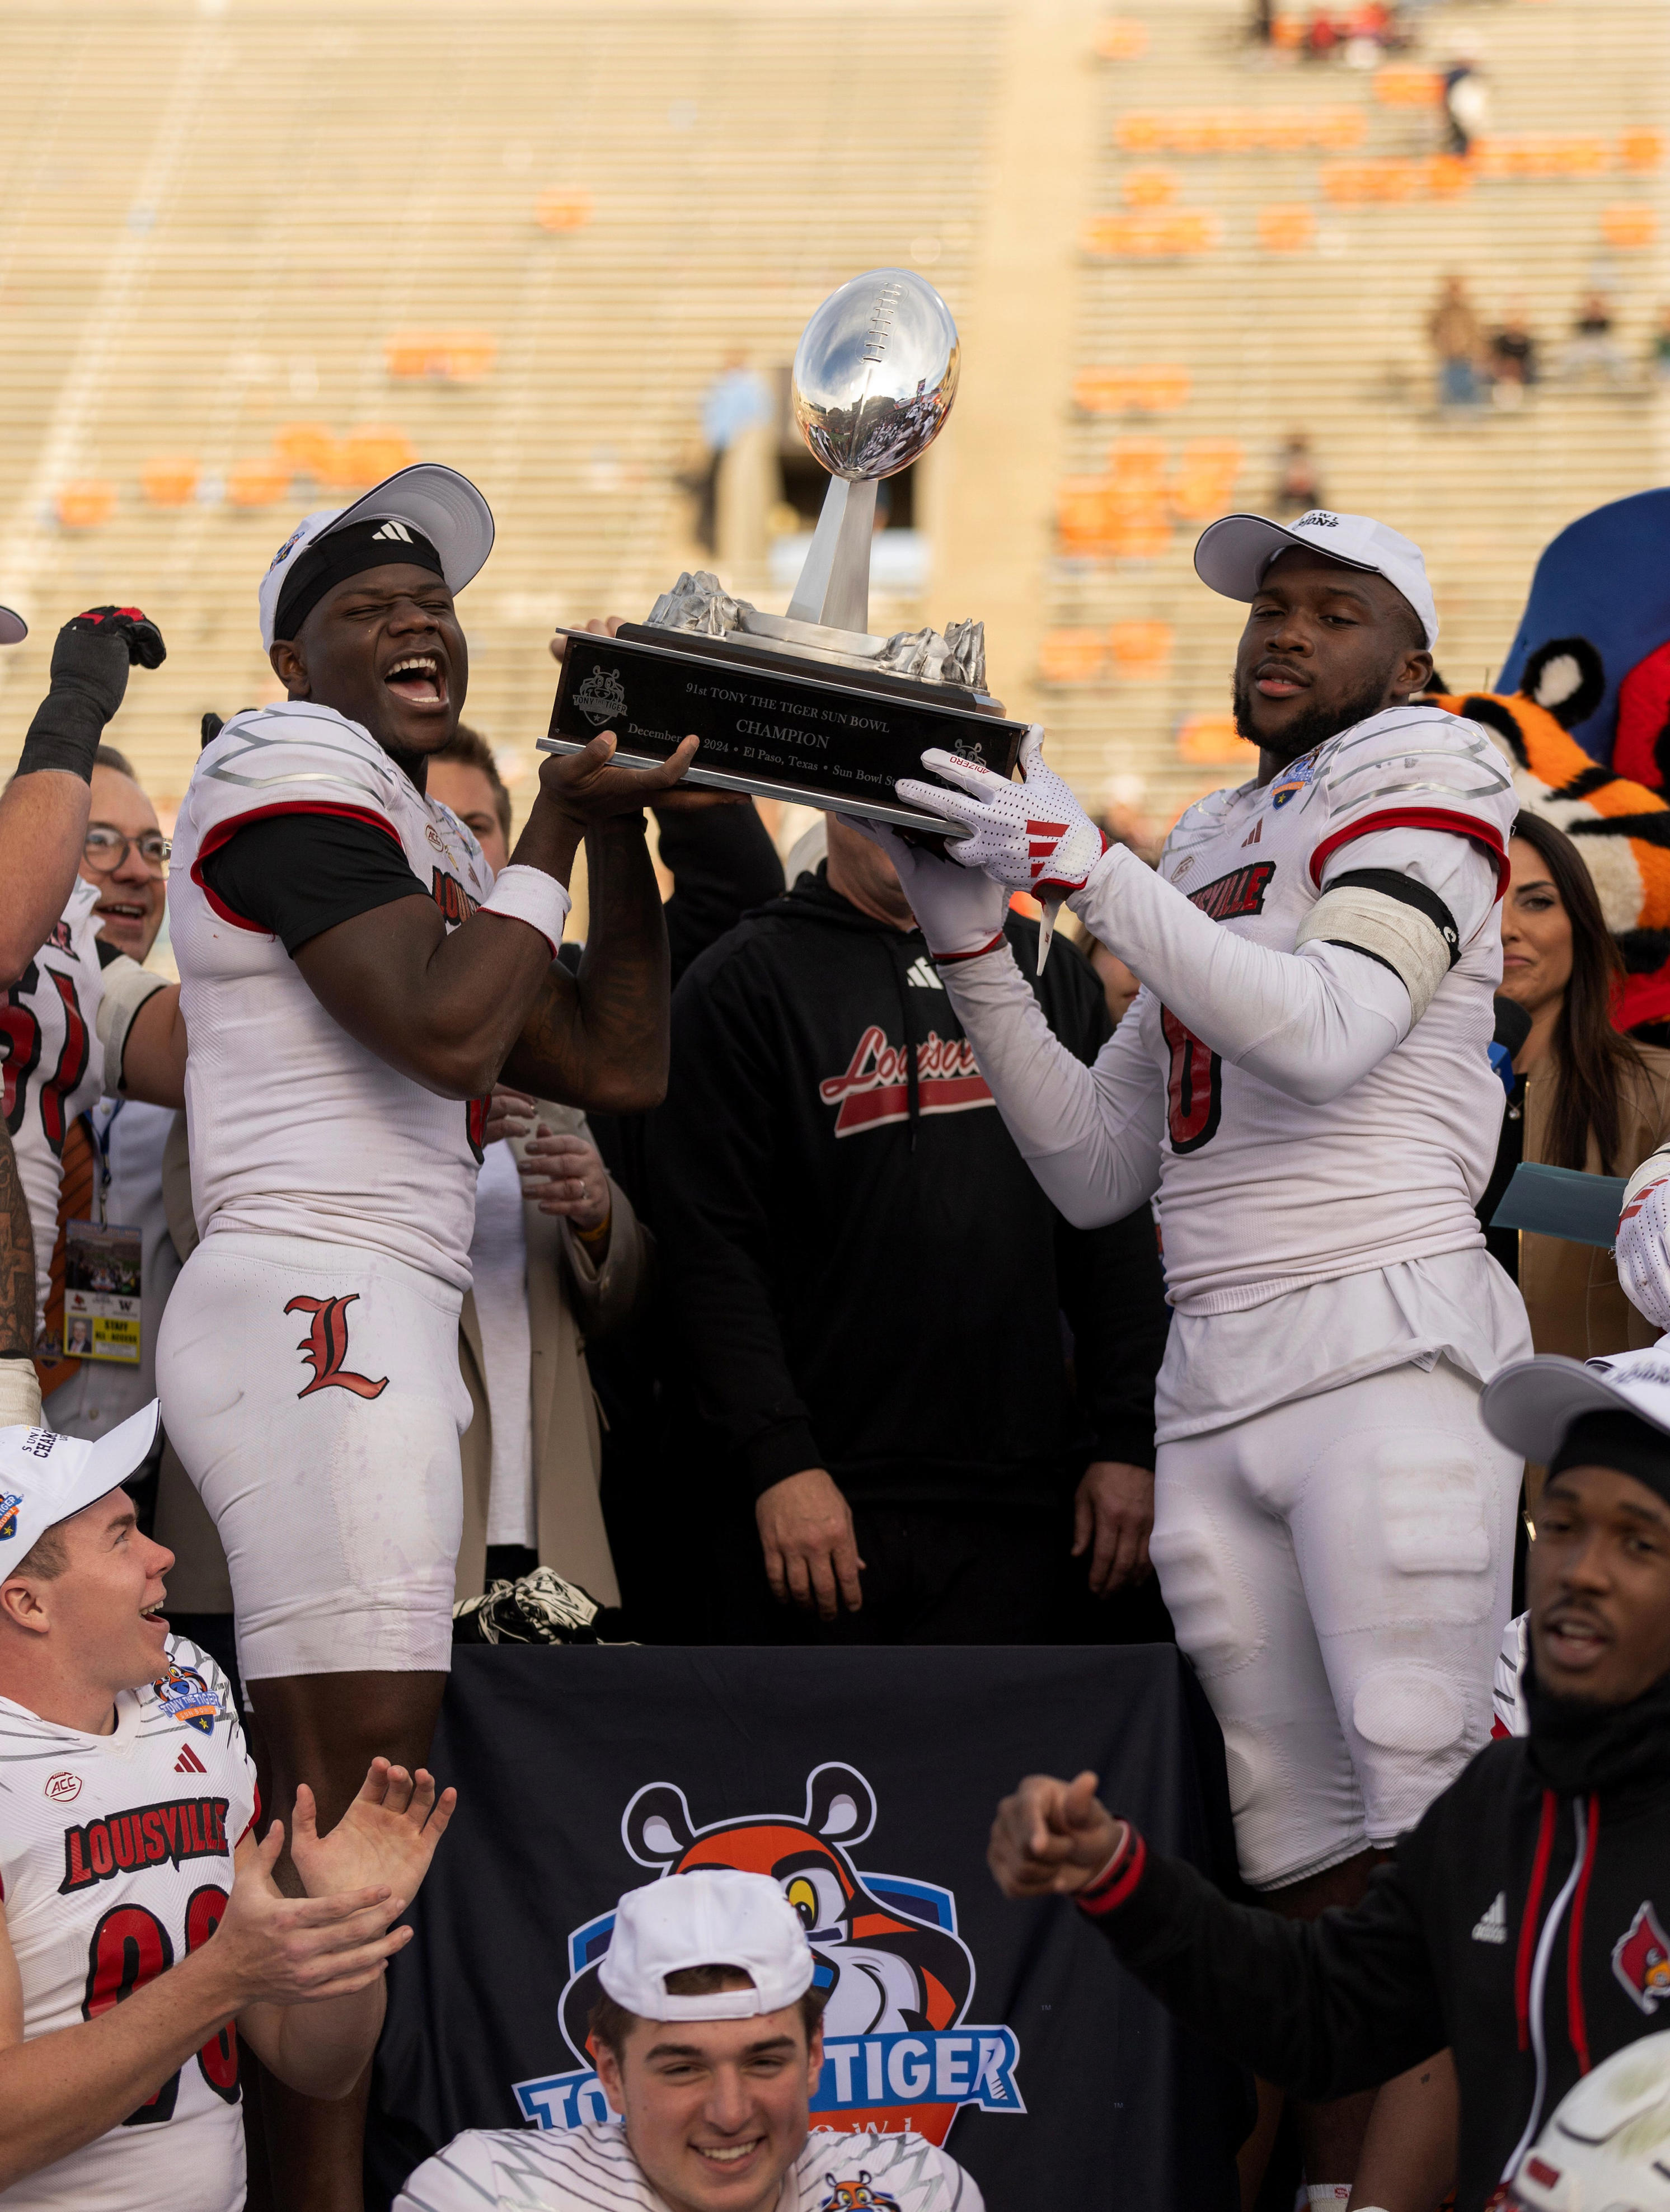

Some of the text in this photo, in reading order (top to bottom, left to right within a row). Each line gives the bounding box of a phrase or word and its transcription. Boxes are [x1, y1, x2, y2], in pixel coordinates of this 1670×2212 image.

[574, 696, 594, 705] TONY
[606, 701, 626, 712] TIGER
[686, 683, 890, 733] 91st TONY THE TIGER SUN BOWL
[736, 719, 830, 749] CHAMPION
[627, 722, 682, 743] December
[703, 738, 729, 753] 2024
[743, 746, 755, 758] El
[757, 749, 784, 765] Paso,
[788, 755, 818, 771] Texas
[833, 764, 853, 778] Sun
[855, 769, 883, 784] Bowl
[949, 756, 991, 774] ADIZERO
[428, 830, 440, 844] ACC
[22, 1432, 39, 1452] SUN
[160, 1692, 221, 1716] TONY THE TIGER
[180, 1711, 194, 1719] SUN
[51, 1776, 76, 1794] ACC
[58, 1797, 229, 1895] LOUISVILLE
[823, 2037, 1009, 2102] TIGER
